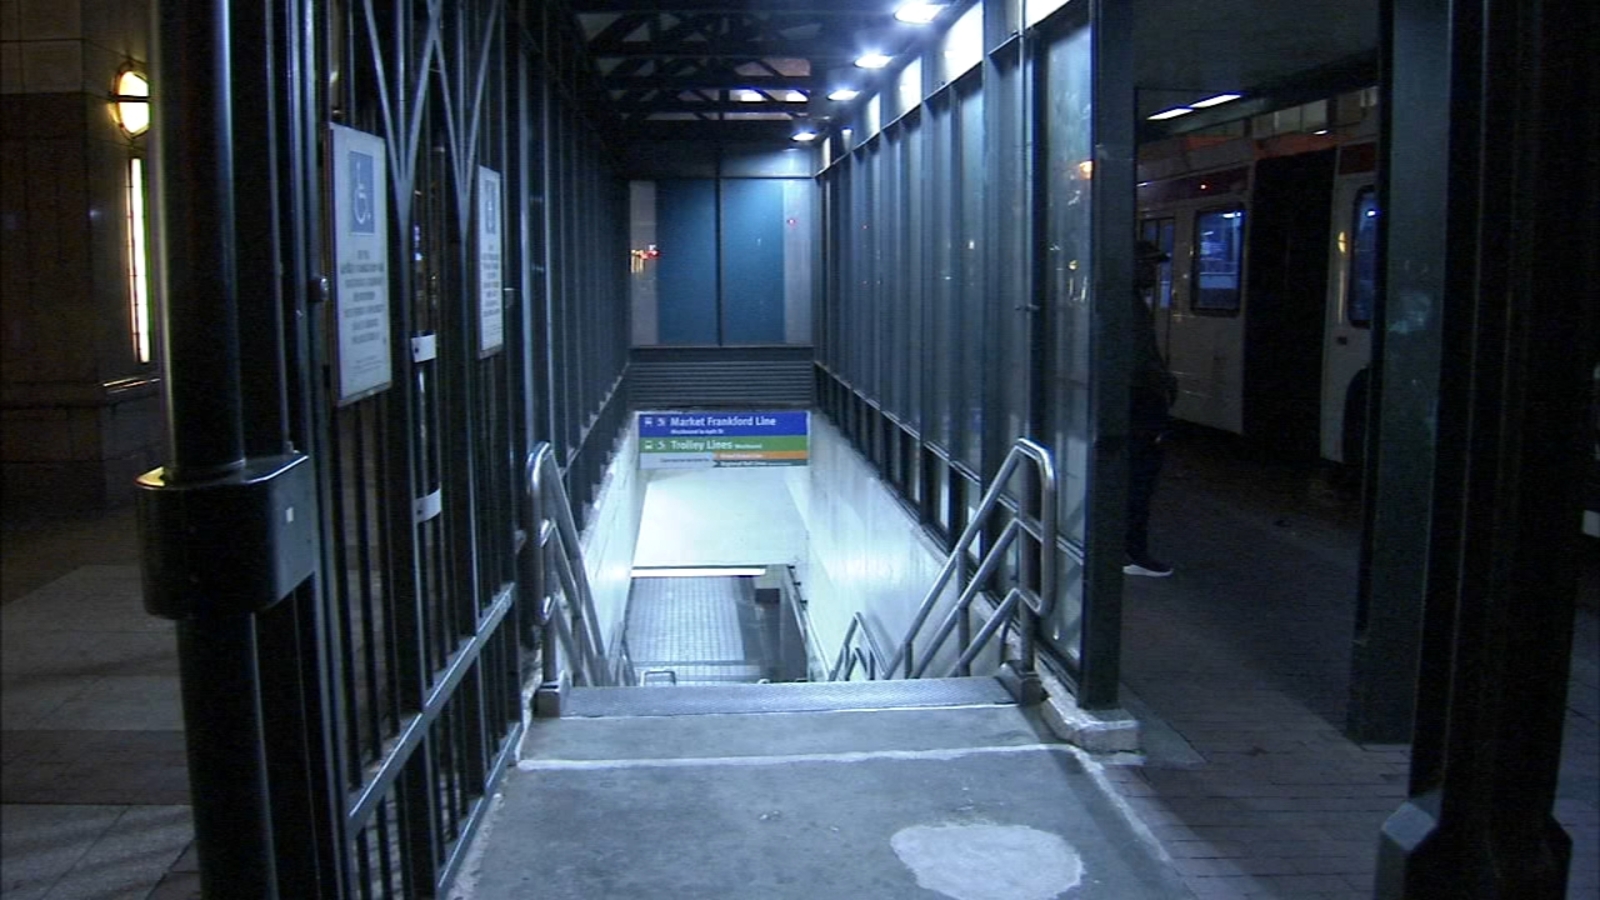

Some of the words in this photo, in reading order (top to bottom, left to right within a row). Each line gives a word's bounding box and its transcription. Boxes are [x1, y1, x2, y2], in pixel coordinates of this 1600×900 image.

[670, 416, 705, 426] Market
[707, 416, 753, 426] Frankford
[755, 416, 776, 426] Line
[670, 440, 704, 451] Trolley
[707, 440, 732, 450] Lines
